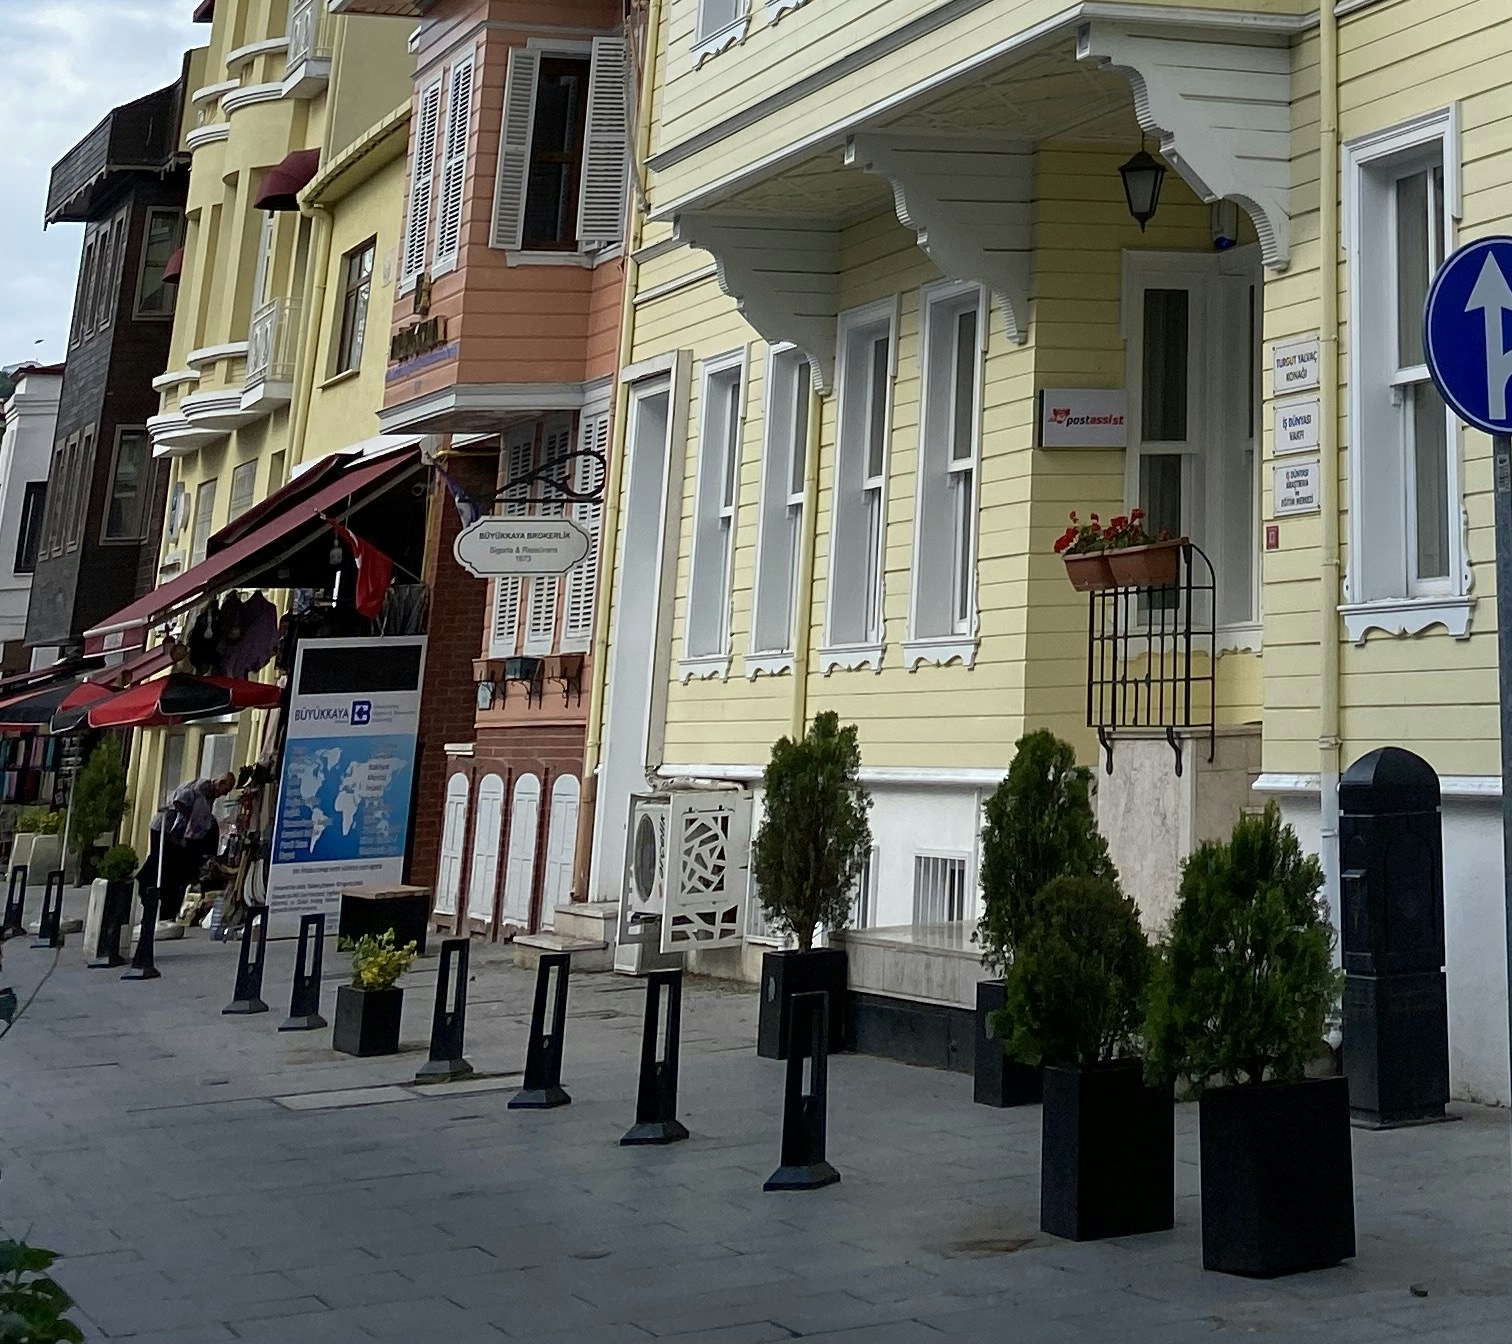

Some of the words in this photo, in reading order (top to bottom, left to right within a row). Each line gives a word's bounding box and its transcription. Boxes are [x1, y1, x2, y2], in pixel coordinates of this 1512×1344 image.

[1066, 414, 1124, 427] postassist
[479, 531, 525, 540] BÜYÜKKAYA
[526, 531, 571, 540] BROKERLİK
[295, 706, 349, 721] BÜYÜKKAYA
